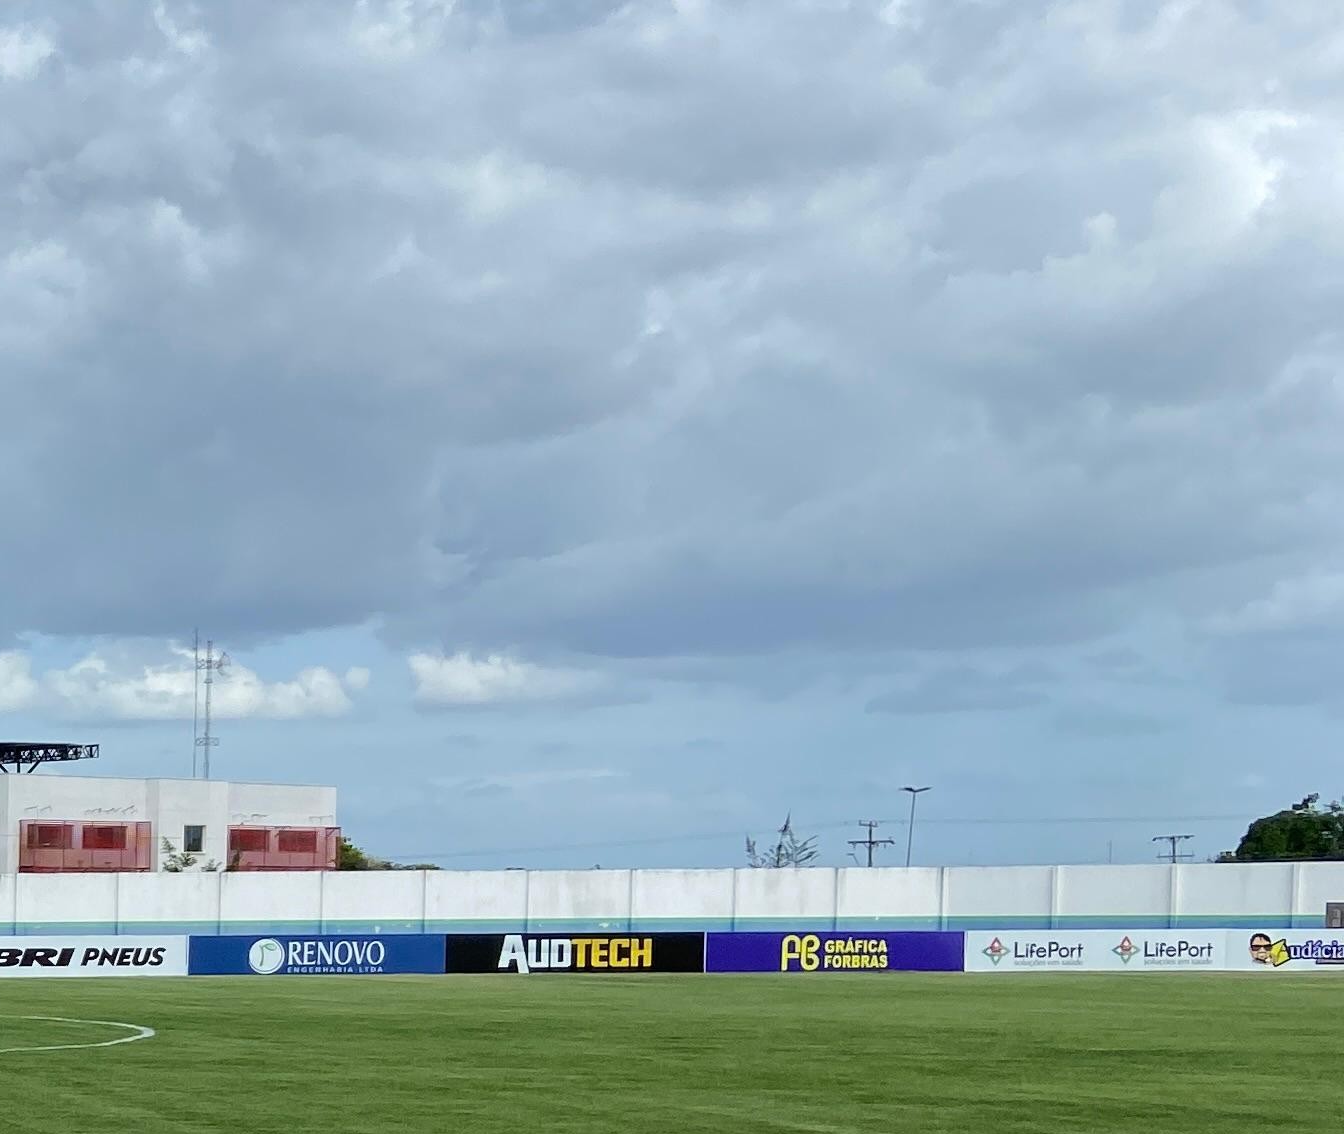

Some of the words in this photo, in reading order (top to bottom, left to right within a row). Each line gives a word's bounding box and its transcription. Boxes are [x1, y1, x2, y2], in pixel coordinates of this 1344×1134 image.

[287, 940, 385, 966] RENOVO
[497, 934, 653, 973] AUDTECH
[824, 937, 888, 953] GRÁFICA
[1013, 941, 1084, 958] LifePort
[1143, 940, 1214, 957] LifePort
[80, 946, 166, 966] PNEUS
[824, 954, 888, 968] FORBRAS
[287, 965, 357, 973] ENGENHARIA
[360, 965, 384, 973] LTDA
